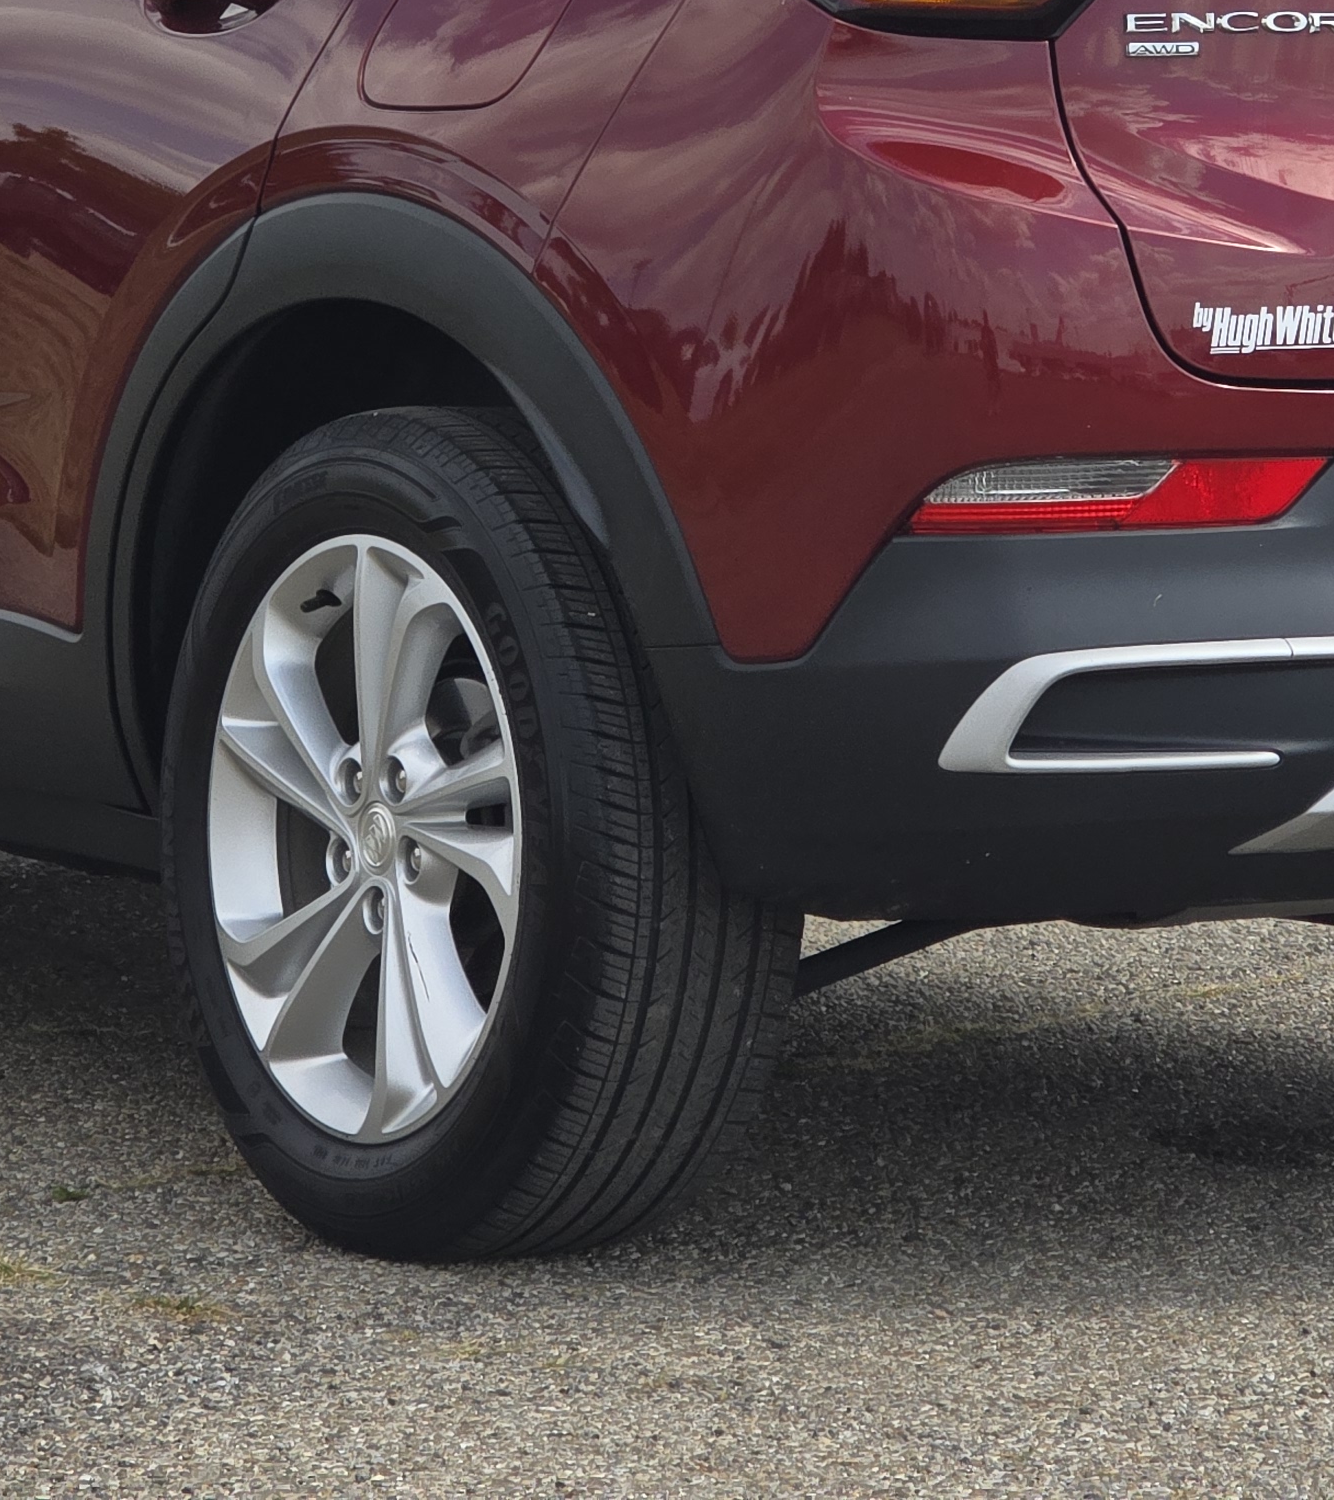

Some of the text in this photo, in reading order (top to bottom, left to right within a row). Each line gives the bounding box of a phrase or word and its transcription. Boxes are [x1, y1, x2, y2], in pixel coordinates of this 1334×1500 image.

[1129, 42, 1197, 56] AWD
[1192, 302, 1214, 332] by
[1210, 306, 1274, 354] Hugh
